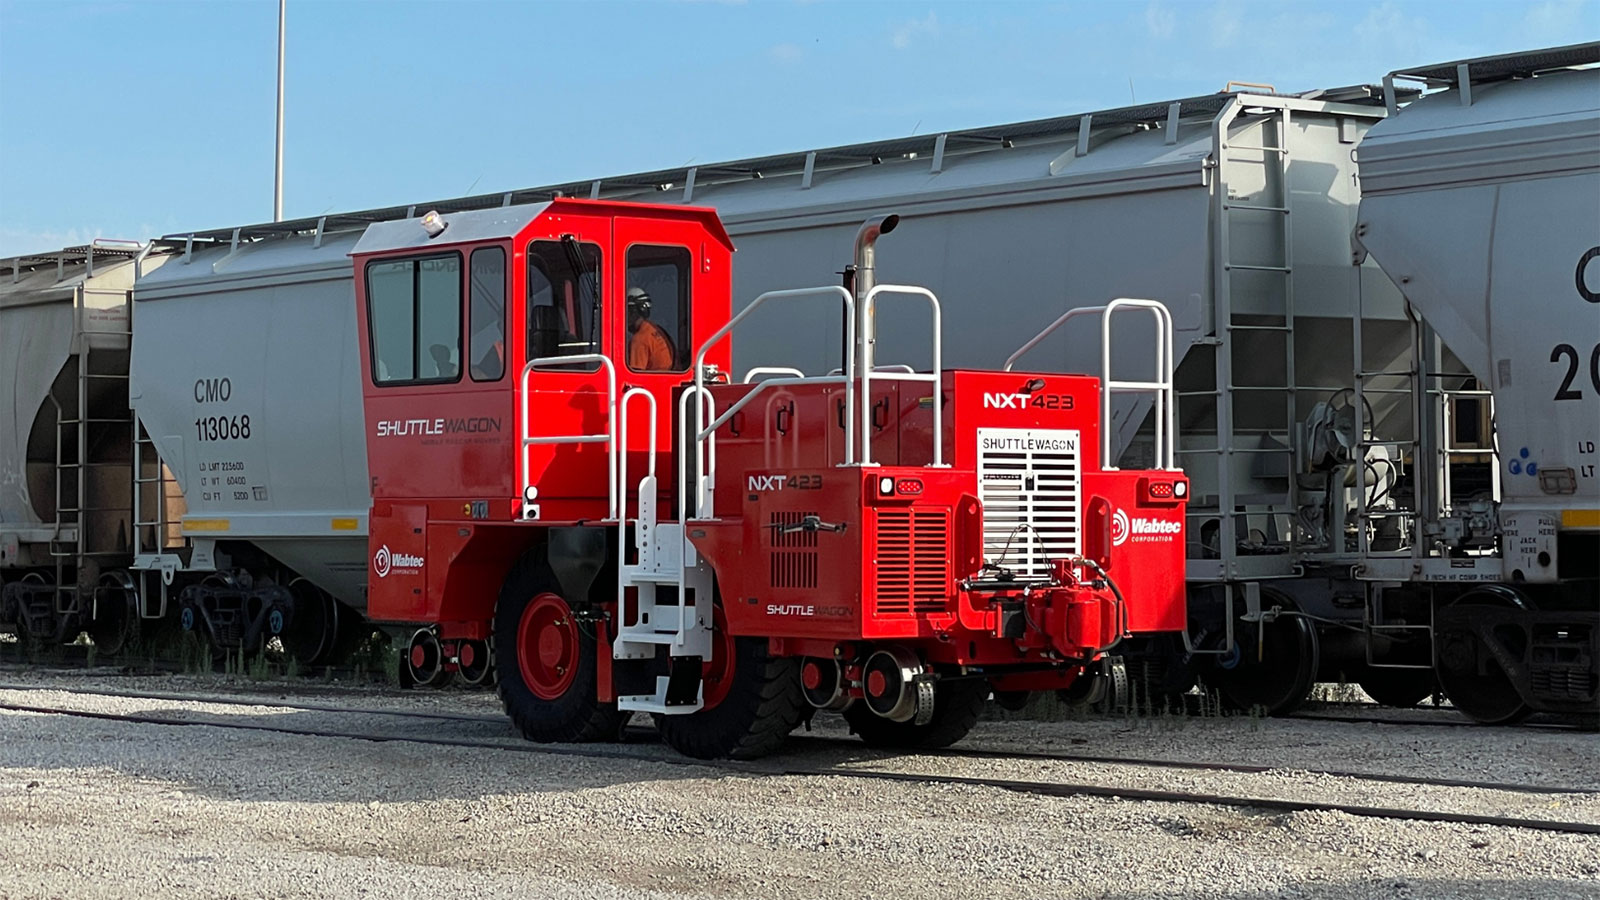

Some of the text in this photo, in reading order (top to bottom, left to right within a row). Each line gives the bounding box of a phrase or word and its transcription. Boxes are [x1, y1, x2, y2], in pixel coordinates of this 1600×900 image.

[194, 377, 231, 403] CMO
[195, 414, 250, 441] 113068
[1578, 441, 1595, 454] LD
[199, 463, 207, 472] LD
[208, 462, 220, 472] LMT
[1581, 465, 1595, 478] LT
[213, 492, 221, 501] FT
[1131, 517, 1181, 534] Wabtec
[1131, 535, 1173, 543] CORPORATION
[391, 553, 424, 567] Wabtec
